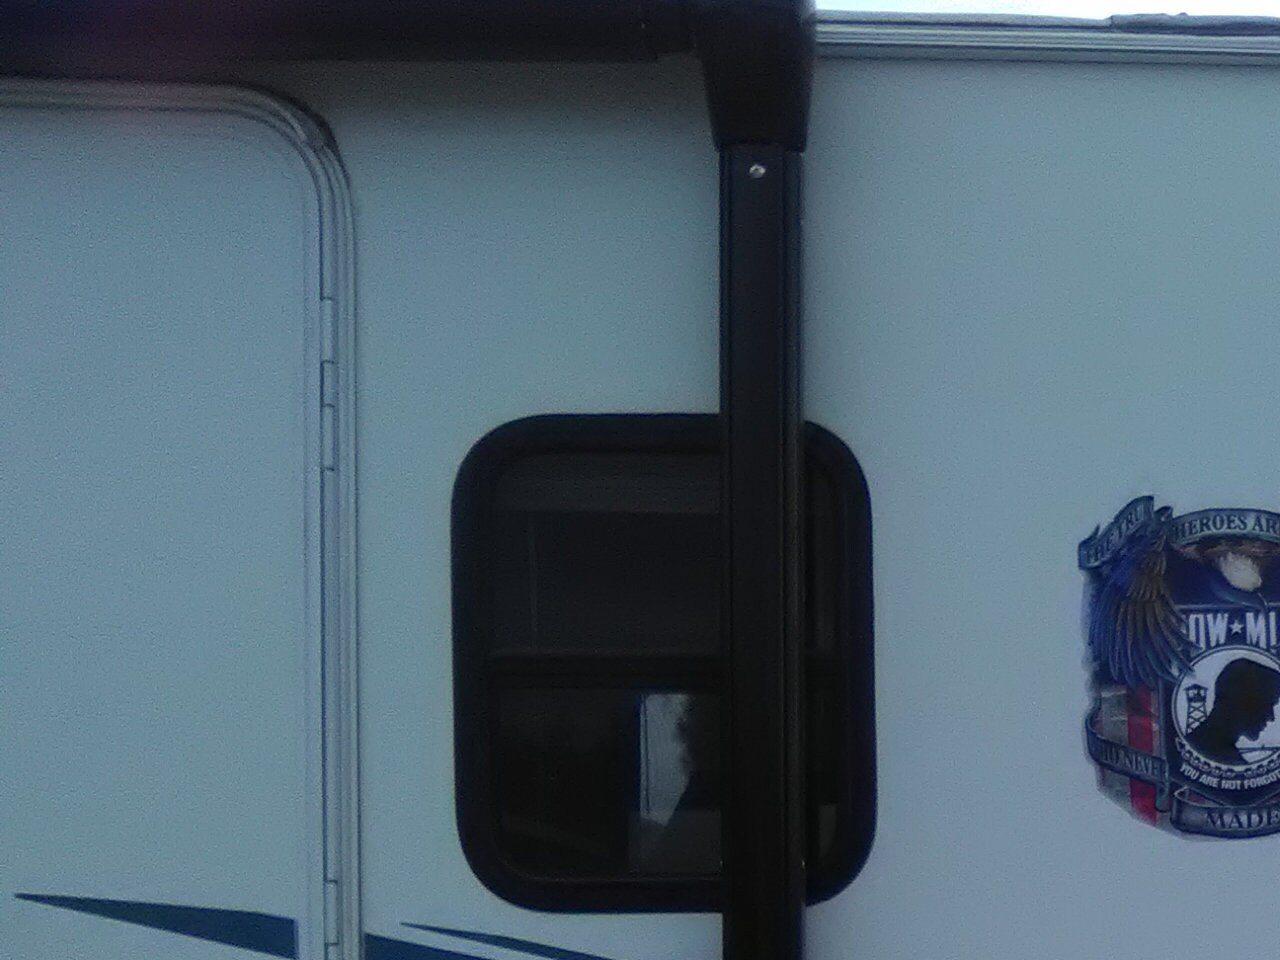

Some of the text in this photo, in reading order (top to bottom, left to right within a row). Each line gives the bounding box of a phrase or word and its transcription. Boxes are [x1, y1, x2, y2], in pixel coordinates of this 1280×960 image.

[1173, 514, 1248, 539] HEROES
[1179, 761, 1200, 781] YOU
[1198, 775, 1220, 788] ARE
[1221, 779, 1242, 790] NOT
[1206, 808, 1280, 830] MADE
